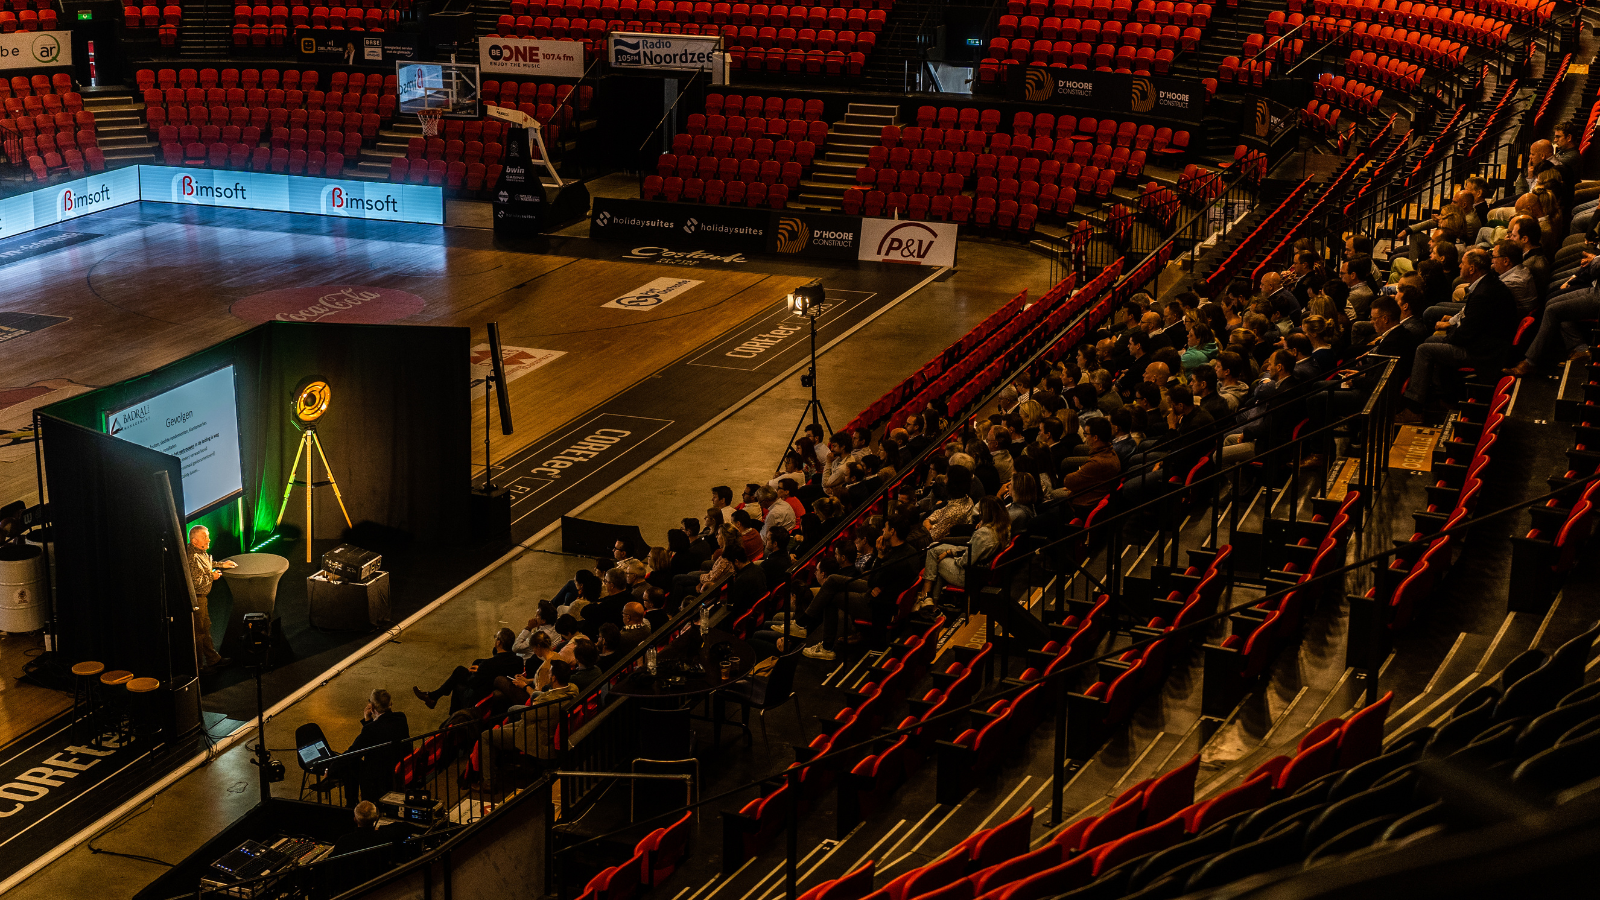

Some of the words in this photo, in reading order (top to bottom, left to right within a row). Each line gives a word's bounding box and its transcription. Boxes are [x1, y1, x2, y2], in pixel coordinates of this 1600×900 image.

[642, 39, 671, 50] Radio
[502, 44, 540, 63] ONE
[542, 52, 562, 61] 107.4
[562, 53, 574, 62] fm
[642, 49, 713, 65] Noordzee
[1058, 79, 1093, 91] D'HOORE
[1159, 90, 1190, 102] D'HOORE
[505, 165, 525, 174] bwin
[612, 215, 675, 229] holidaysuites
[700, 222, 764, 236] holidaysuites
[813, 229, 854, 241] D'HOORE
[884, 237, 935, 259] P&V
[725, 323, 802, 359] COREtec
[165, 410, 194, 428] Gevolgen
[530, 428, 632, 479] COREtec
